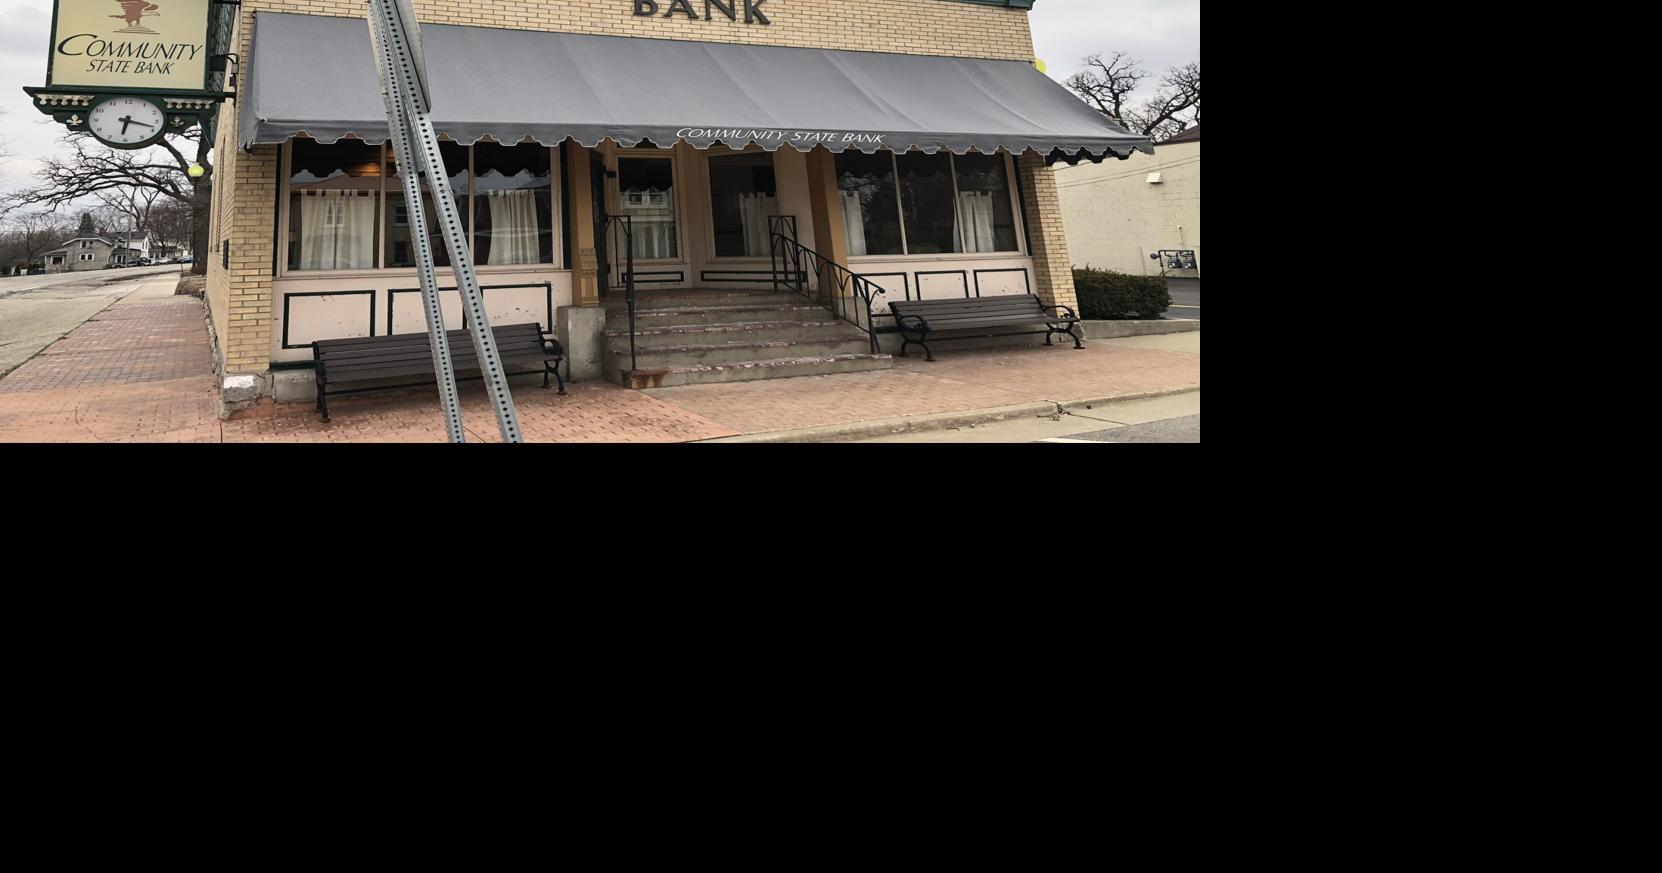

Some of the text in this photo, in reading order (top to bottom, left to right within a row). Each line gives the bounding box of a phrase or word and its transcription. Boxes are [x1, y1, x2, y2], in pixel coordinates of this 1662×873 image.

[633, 0, 771, 25] BANK
[57, 33, 203, 60] COMMUNITY
[86, 59, 175, 75] STATE BANK
[676, 127, 885, 143] COMMUNITY STATE BANK
